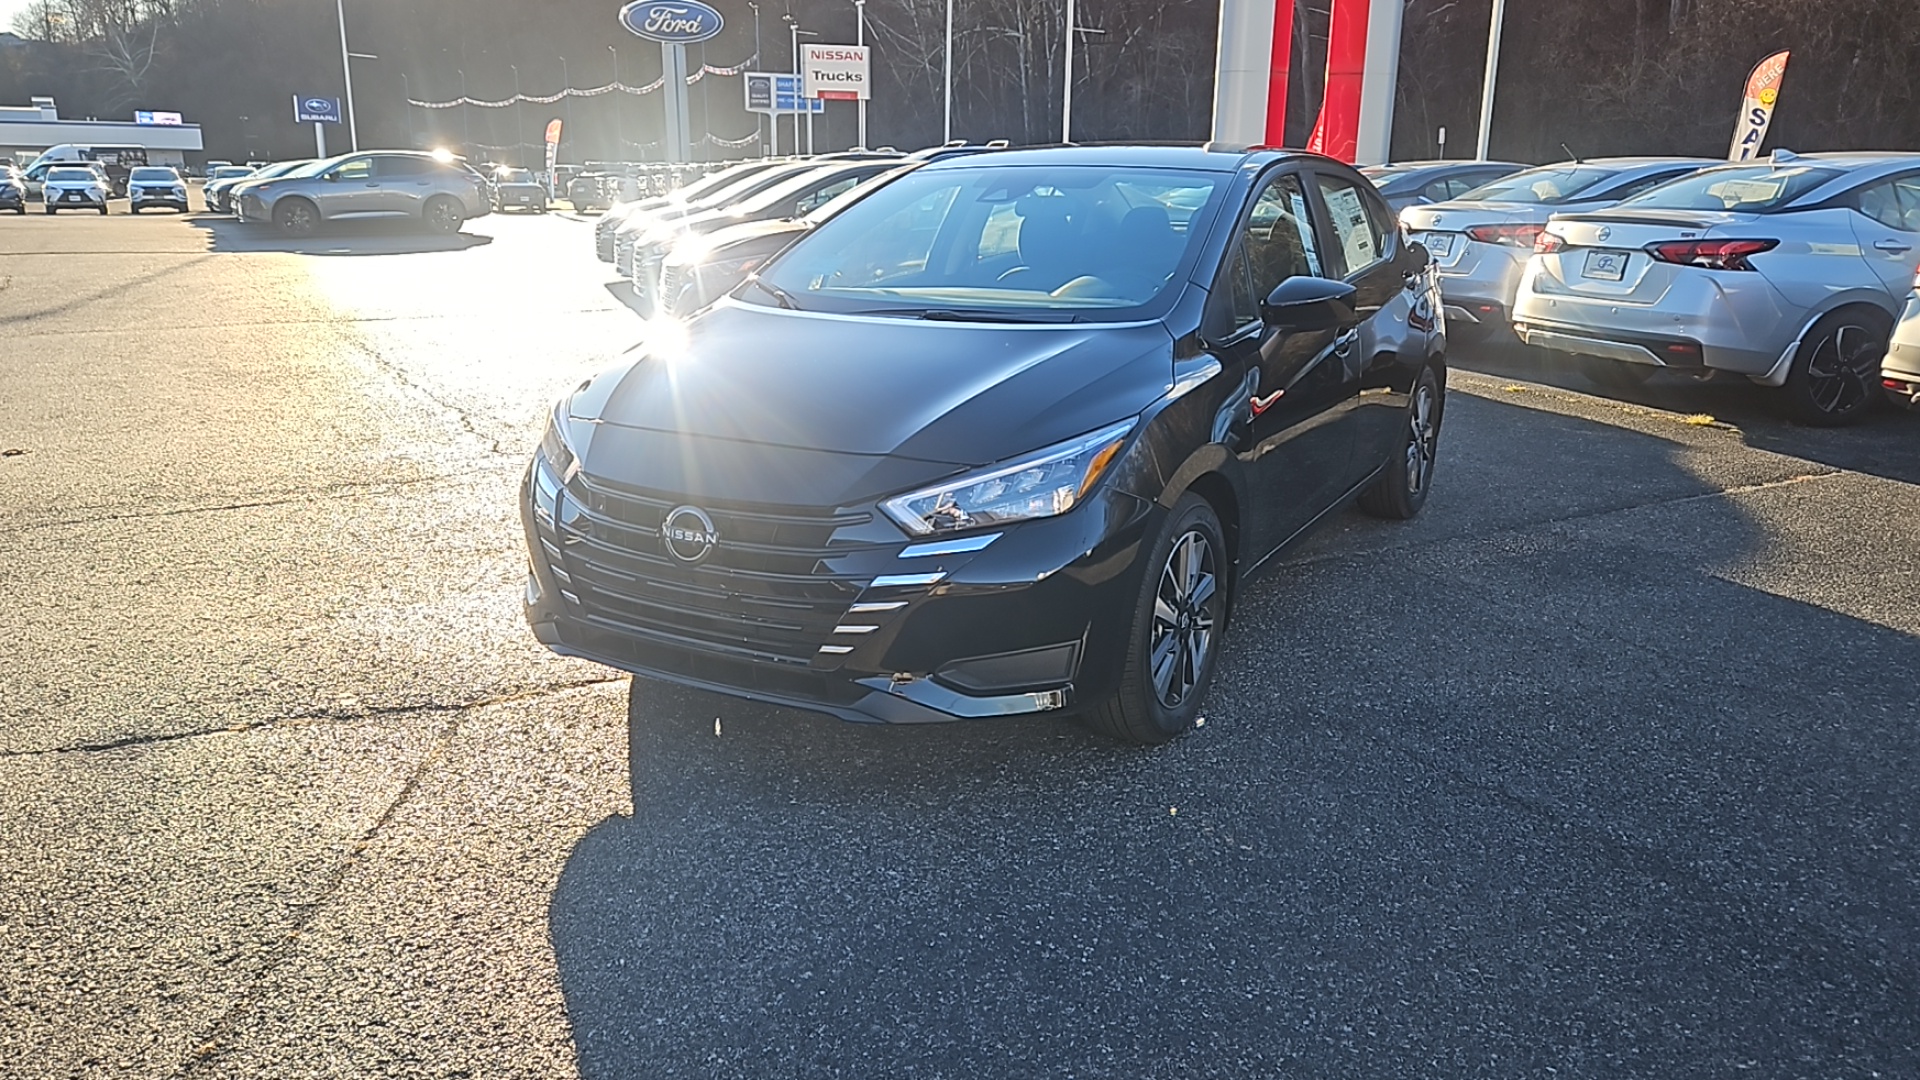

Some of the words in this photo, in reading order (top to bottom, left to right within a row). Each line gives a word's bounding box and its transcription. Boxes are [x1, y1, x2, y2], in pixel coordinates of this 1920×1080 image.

[645, 6, 703, 34] Ford
[811, 50, 863, 61] NISSAN
[812, 70, 863, 82] Trucks
[1756, 64, 1784, 88] HERE
[300, 114, 338, 122] SUBARU
[662, 526, 717, 544] NISSAN
